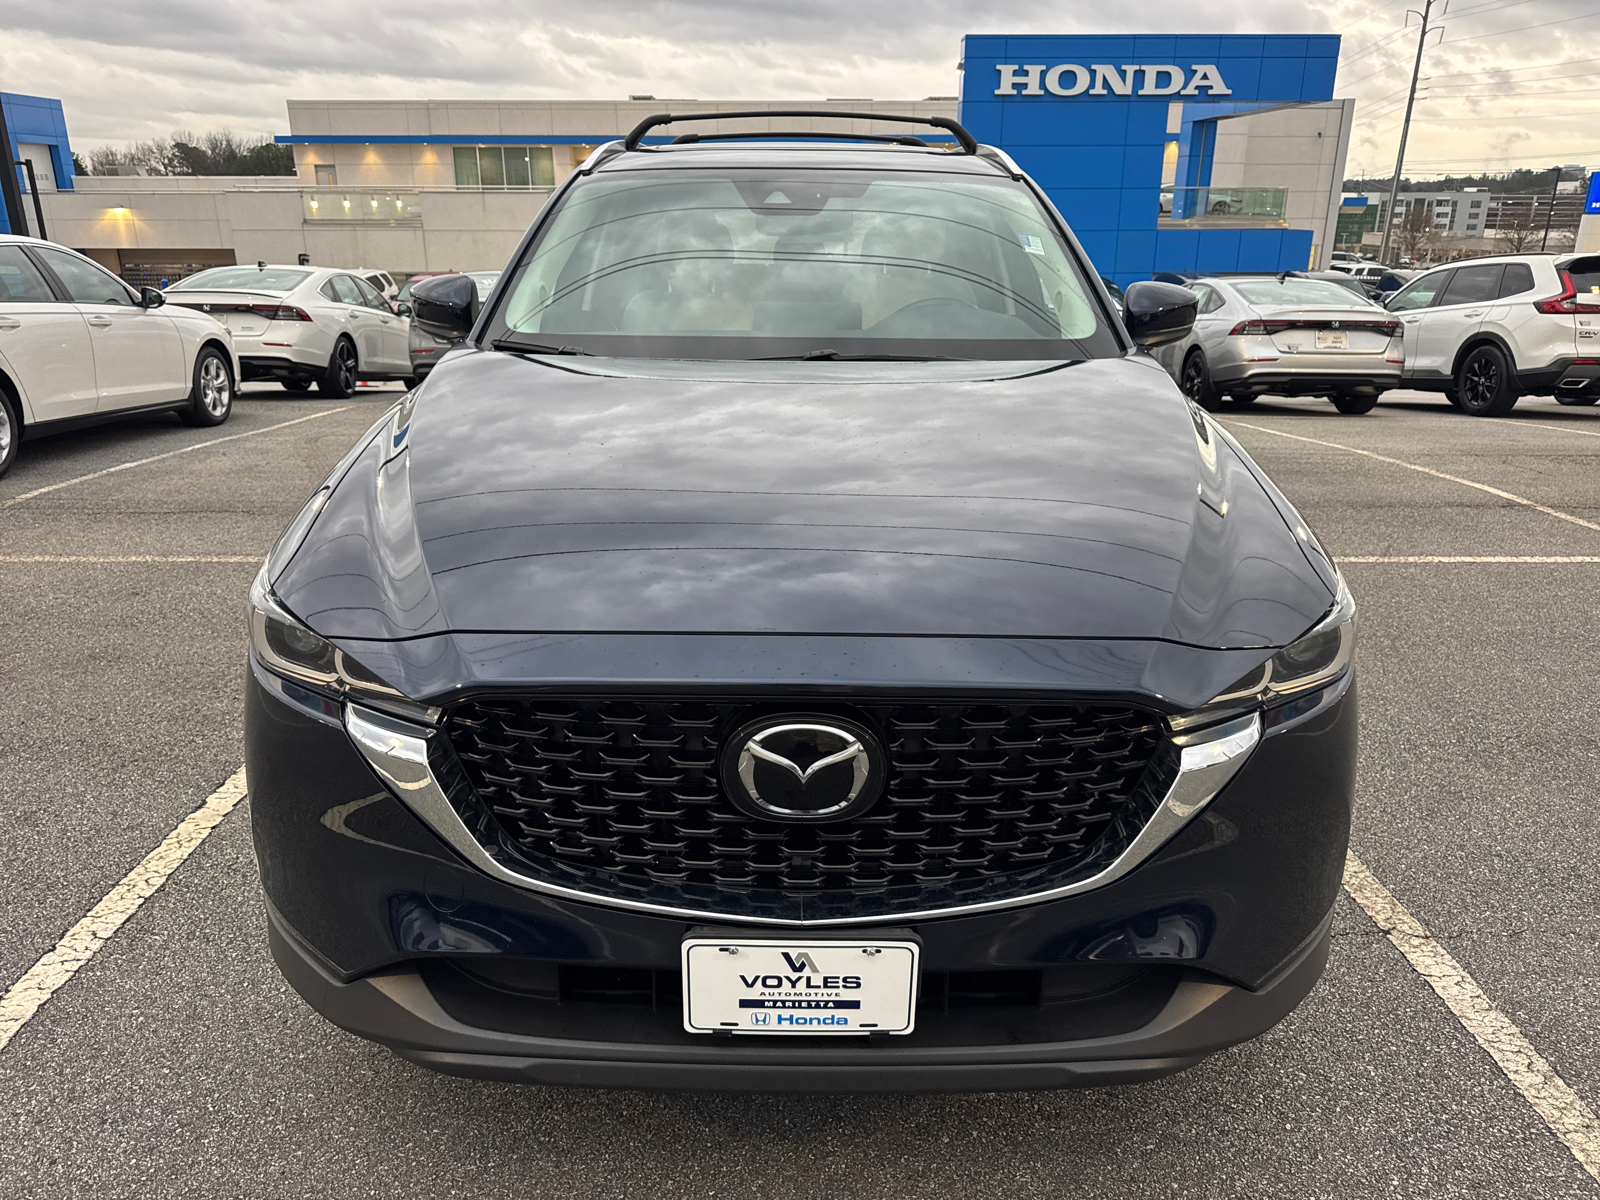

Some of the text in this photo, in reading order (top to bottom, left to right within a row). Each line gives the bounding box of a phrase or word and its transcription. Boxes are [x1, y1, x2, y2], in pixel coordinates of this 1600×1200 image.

[994, 64, 1232, 96] HONDA
[739, 974, 862, 989] VOYLES
[777, 1014, 849, 1025] Honda
